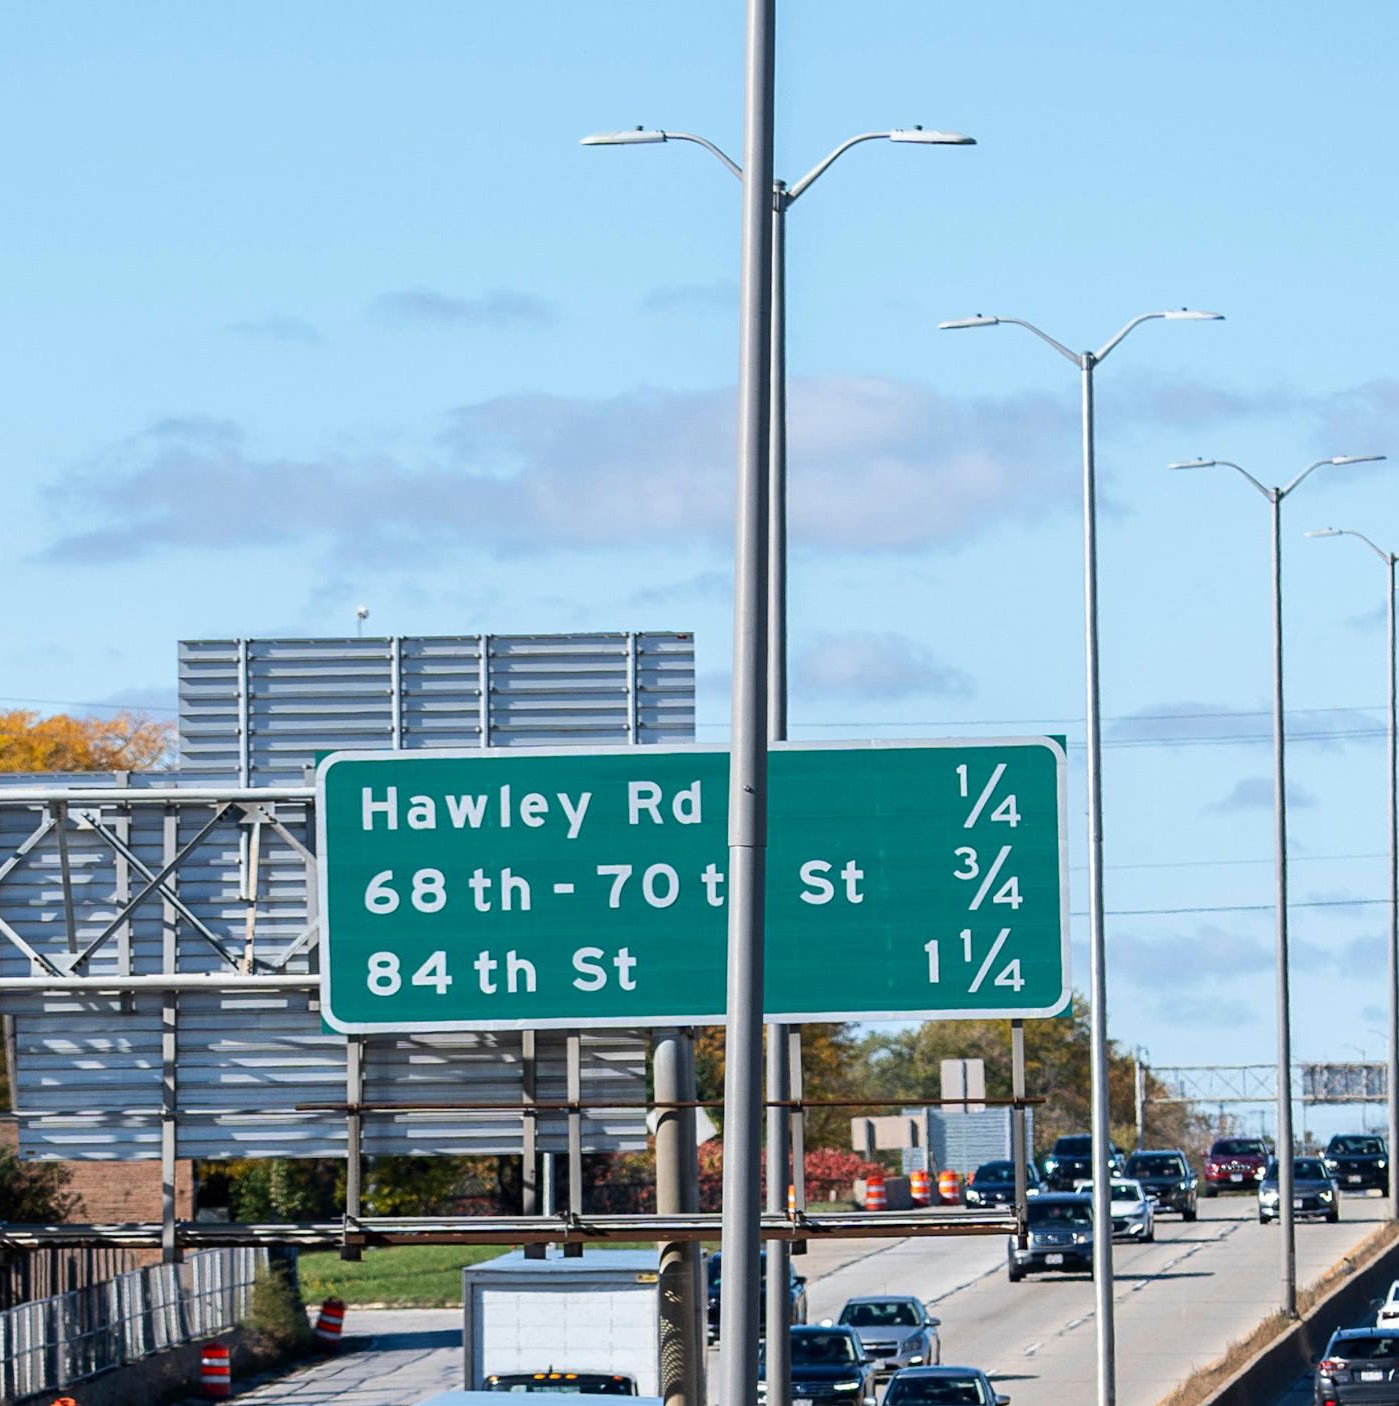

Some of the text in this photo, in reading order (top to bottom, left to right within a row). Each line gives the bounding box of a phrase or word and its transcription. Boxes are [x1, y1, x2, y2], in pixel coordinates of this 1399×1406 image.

[362, 780, 702, 839] Hawley Rd
[800, 859, 865, 905] St
[367, 946, 638, 996] 84th St
